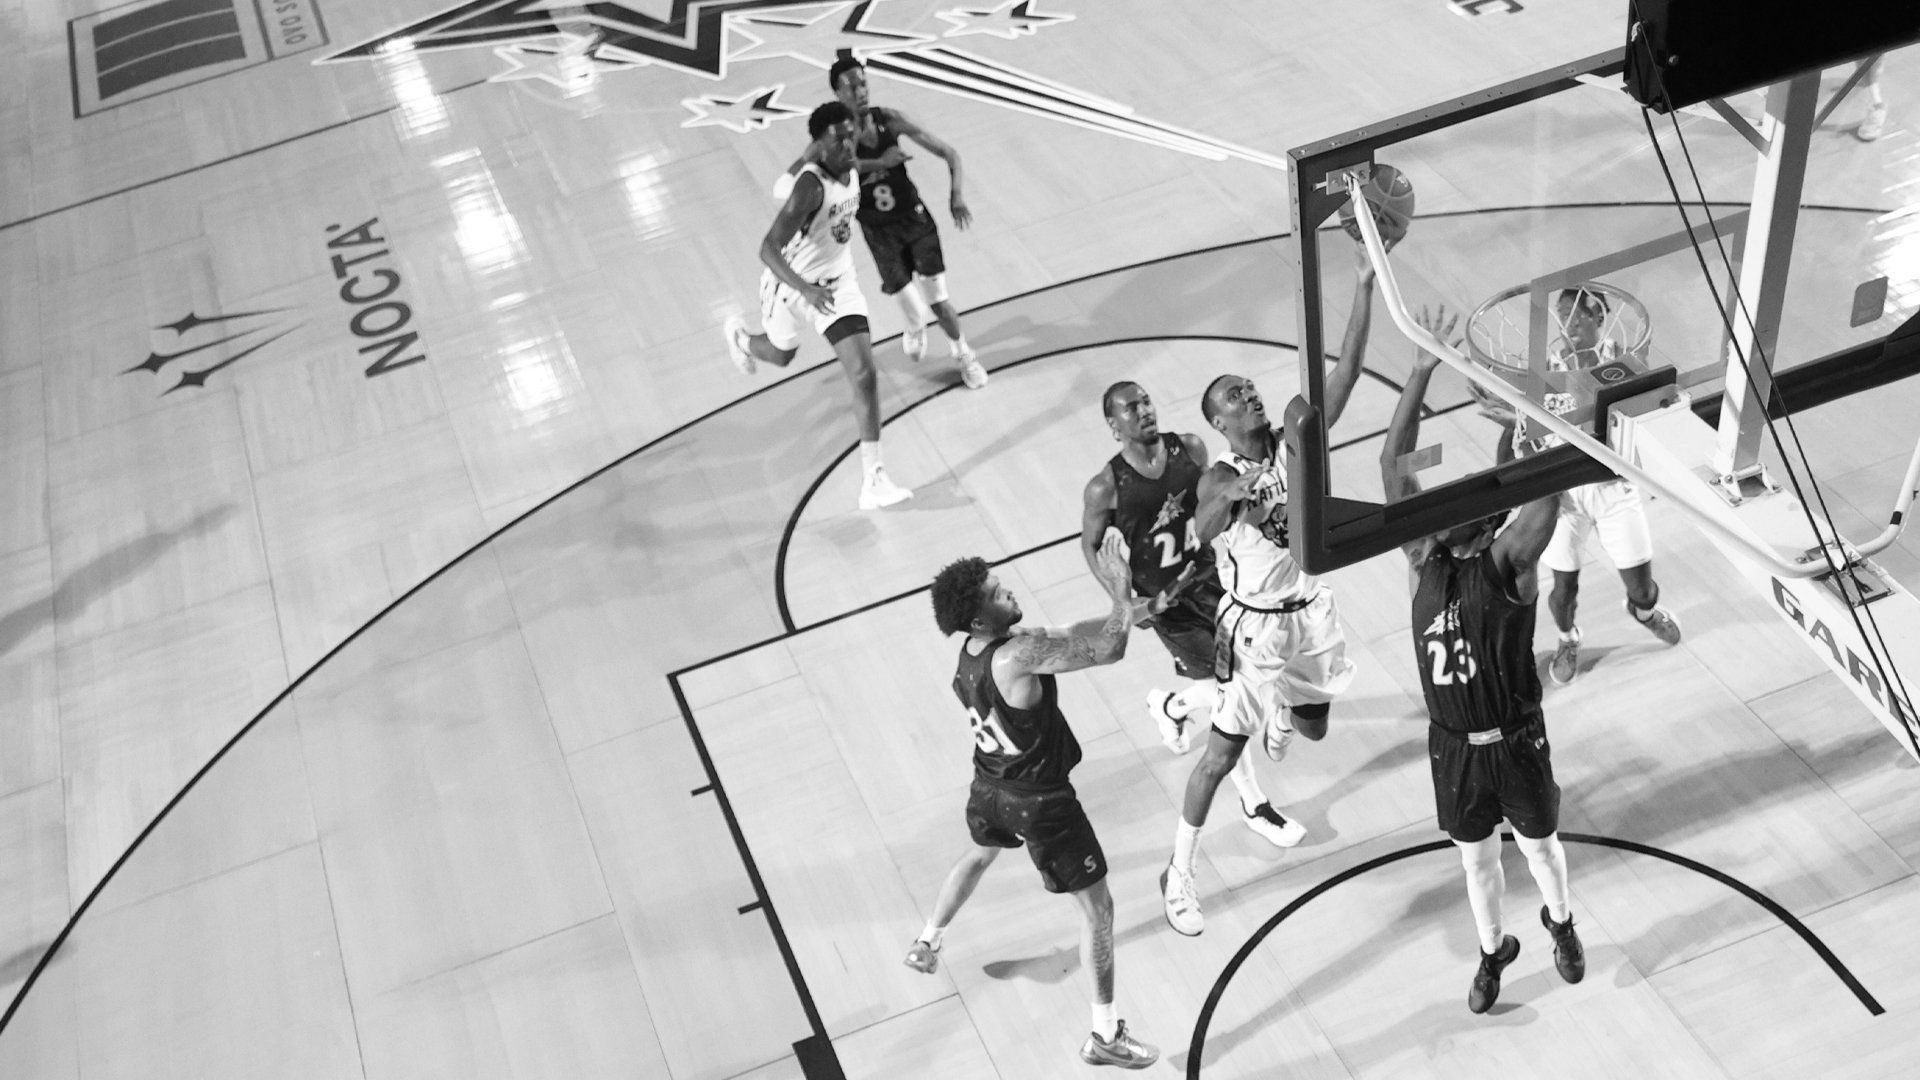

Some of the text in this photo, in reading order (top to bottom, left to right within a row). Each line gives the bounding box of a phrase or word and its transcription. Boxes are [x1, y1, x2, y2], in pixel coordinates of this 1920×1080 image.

[280, 15, 308, 45] OVO
[872, 184, 896, 212] 8
[1153, 516, 1202, 568] 24
[1427, 638, 1477, 686] 23
